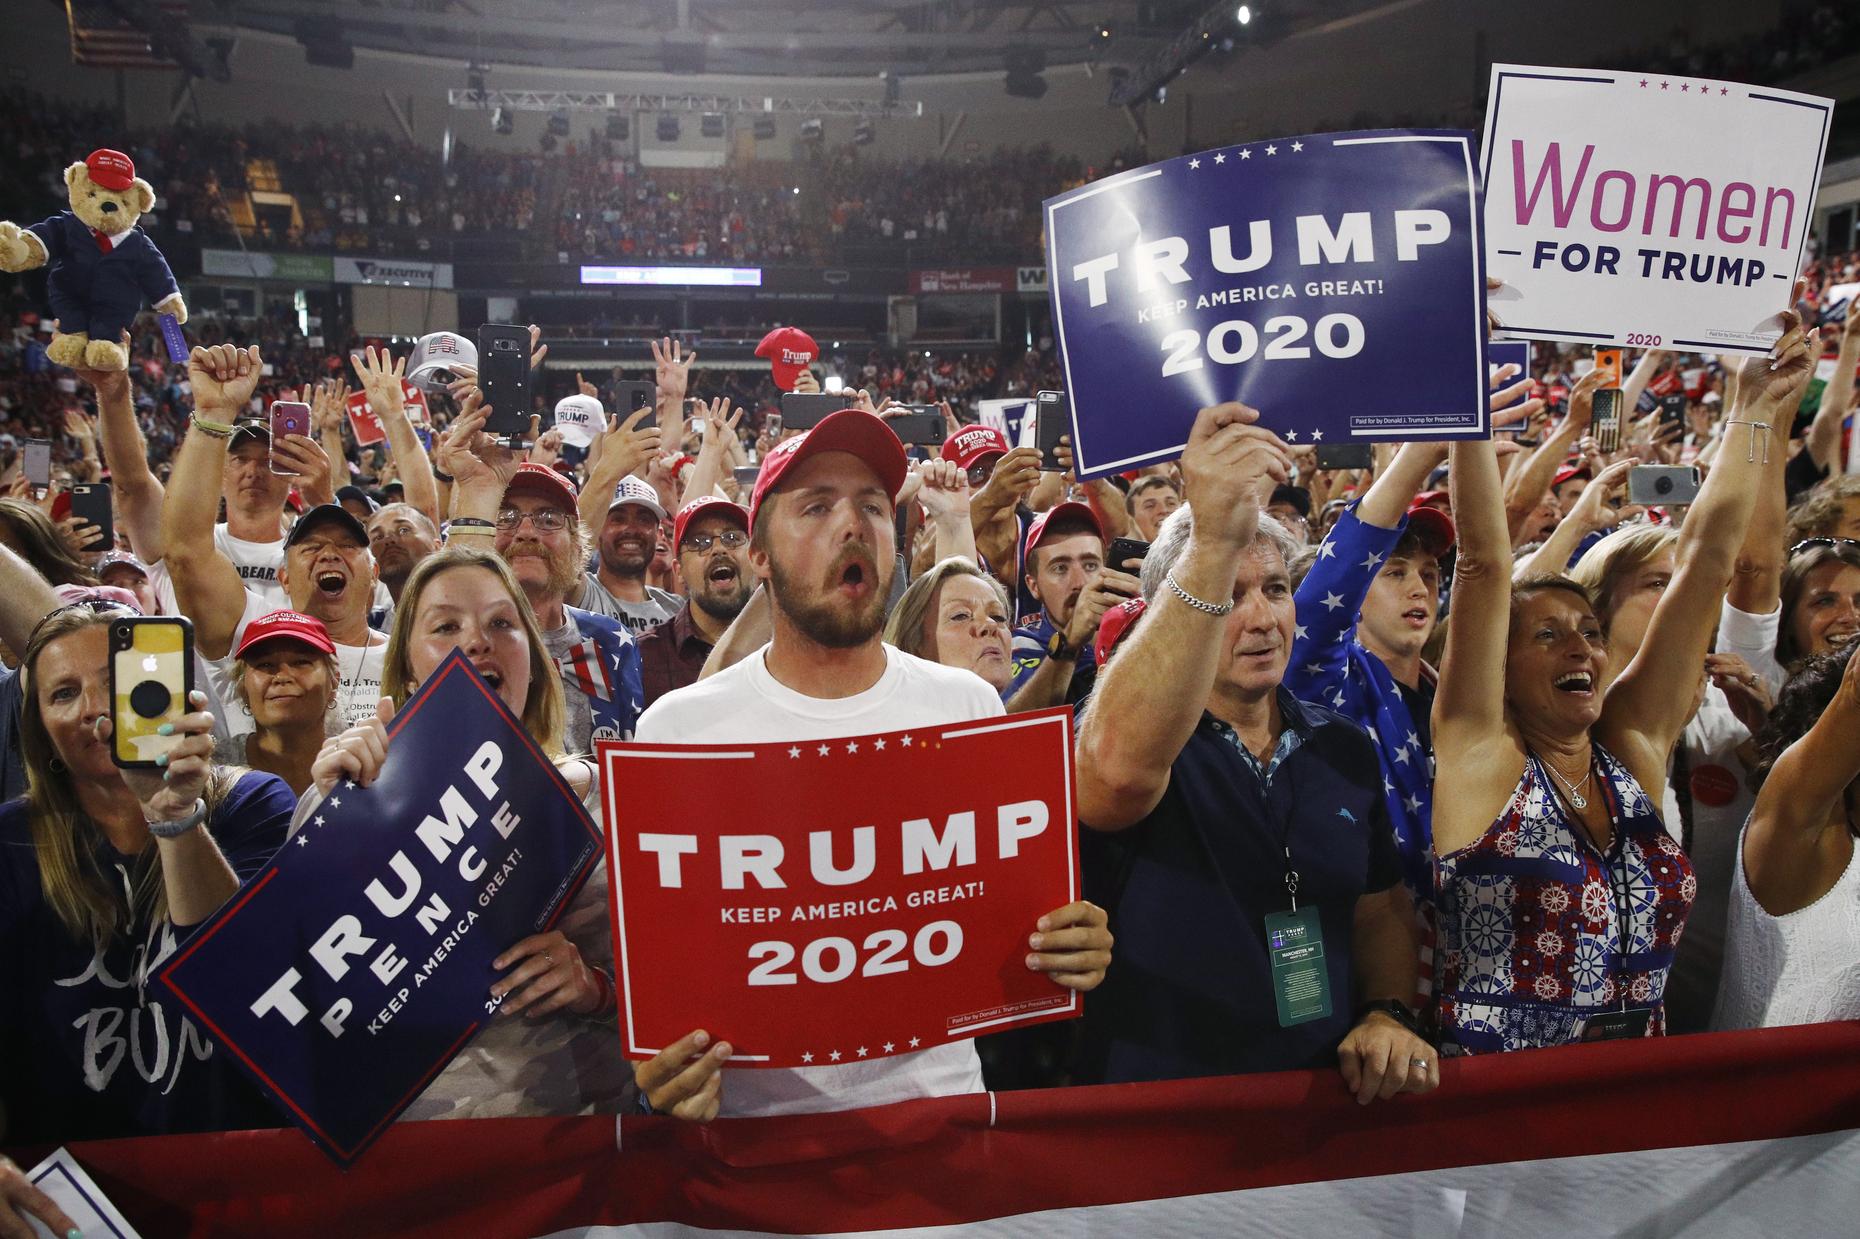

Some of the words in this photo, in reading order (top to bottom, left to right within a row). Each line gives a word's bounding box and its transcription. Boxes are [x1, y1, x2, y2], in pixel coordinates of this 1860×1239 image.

[1511, 139, 1795, 250] Women
[1073, 209, 1451, 307] TRUMP
[1532, 240, 1621, 275] FOR
[1637, 249, 1766, 288] TRUMP
[1138, 299, 1188, 324] KEEP
[1196, 284, 1297, 311] AMERICA
[1304, 279, 1384, 297] GREAT!
[782, 348, 811, 363] Trump
[1161, 313, 1366, 378] 2020
[1626, 333, 1662, 347] 2020
[954, 429, 996, 450] TRUMP
[1408, 417, 1425, 425] Trump
[600, 729, 614, 738] I'M
[638, 799, 1050, 890] TRUMP
[249, 740, 503, 1027] TRUMP
[720, 907, 782, 924] KEEP
[791, 896, 898, 922] AMERICA
[906, 881, 985, 908] GREAT!
[319, 800, 521, 1039] PENCE
[367, 987, 410, 1036] KEEP
[413, 910, 479, 988] AMERICA
[477, 848, 523, 907] GREAT!
[747, 920, 964, 987] 2020
[485, 991, 509, 1015] 20
